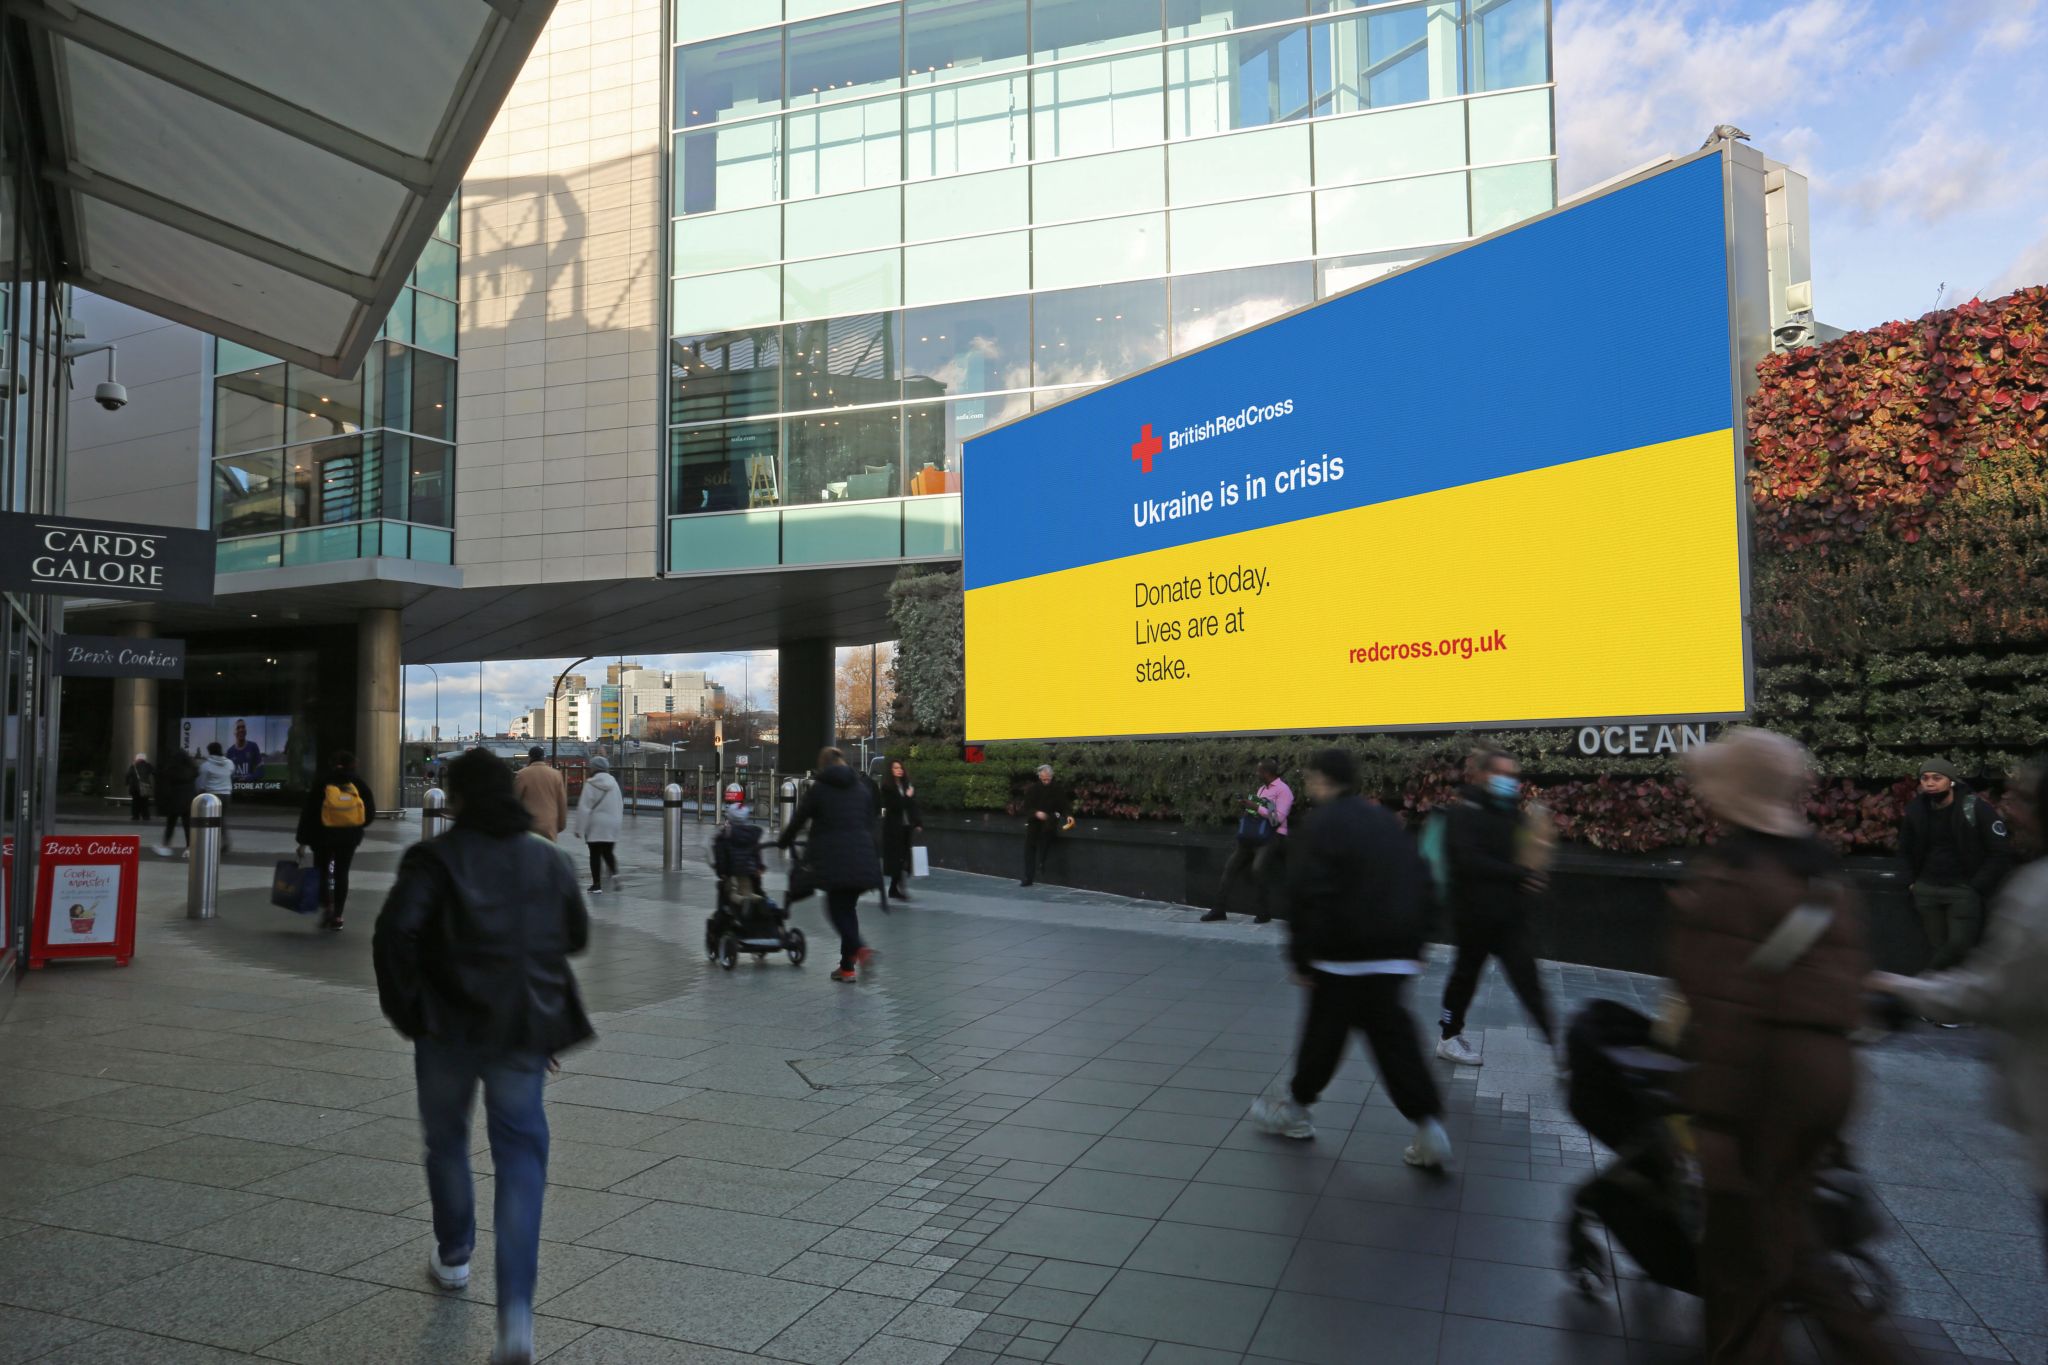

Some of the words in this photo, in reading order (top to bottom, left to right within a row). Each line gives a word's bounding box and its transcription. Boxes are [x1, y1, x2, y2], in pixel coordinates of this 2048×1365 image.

[1169, 398, 1294, 450] BritishRedCross
[1133, 489, 1215, 528] Ukraine
[1220, 480, 1239, 507] is
[1246, 473, 1267, 501] in
[1275, 453, 1345, 494] crisis
[44, 531, 156, 559] CARDS
[32, 556, 164, 585] GALORE
[1135, 576, 1202, 608] Donate
[1208, 564, 1270, 596] today.
[1135, 620, 1182, 645] Lives
[1187, 616, 1219, 639] are
[1225, 606, 1245, 634] at
[68, 646, 114, 664] Ben's
[119, 649, 178, 667] Cookies
[1349, 629, 1508, 664] redcross.org.uk
[1136, 655, 1190, 683] stake.
[1578, 724, 1706, 755] OCEAN
[233, 782, 254, 790] STORE
[254, 782, 264, 790] AT
[264, 782, 281, 790] GAME
[44, 842, 82, 855] Ben's
[88, 842, 135, 855] Cookies
